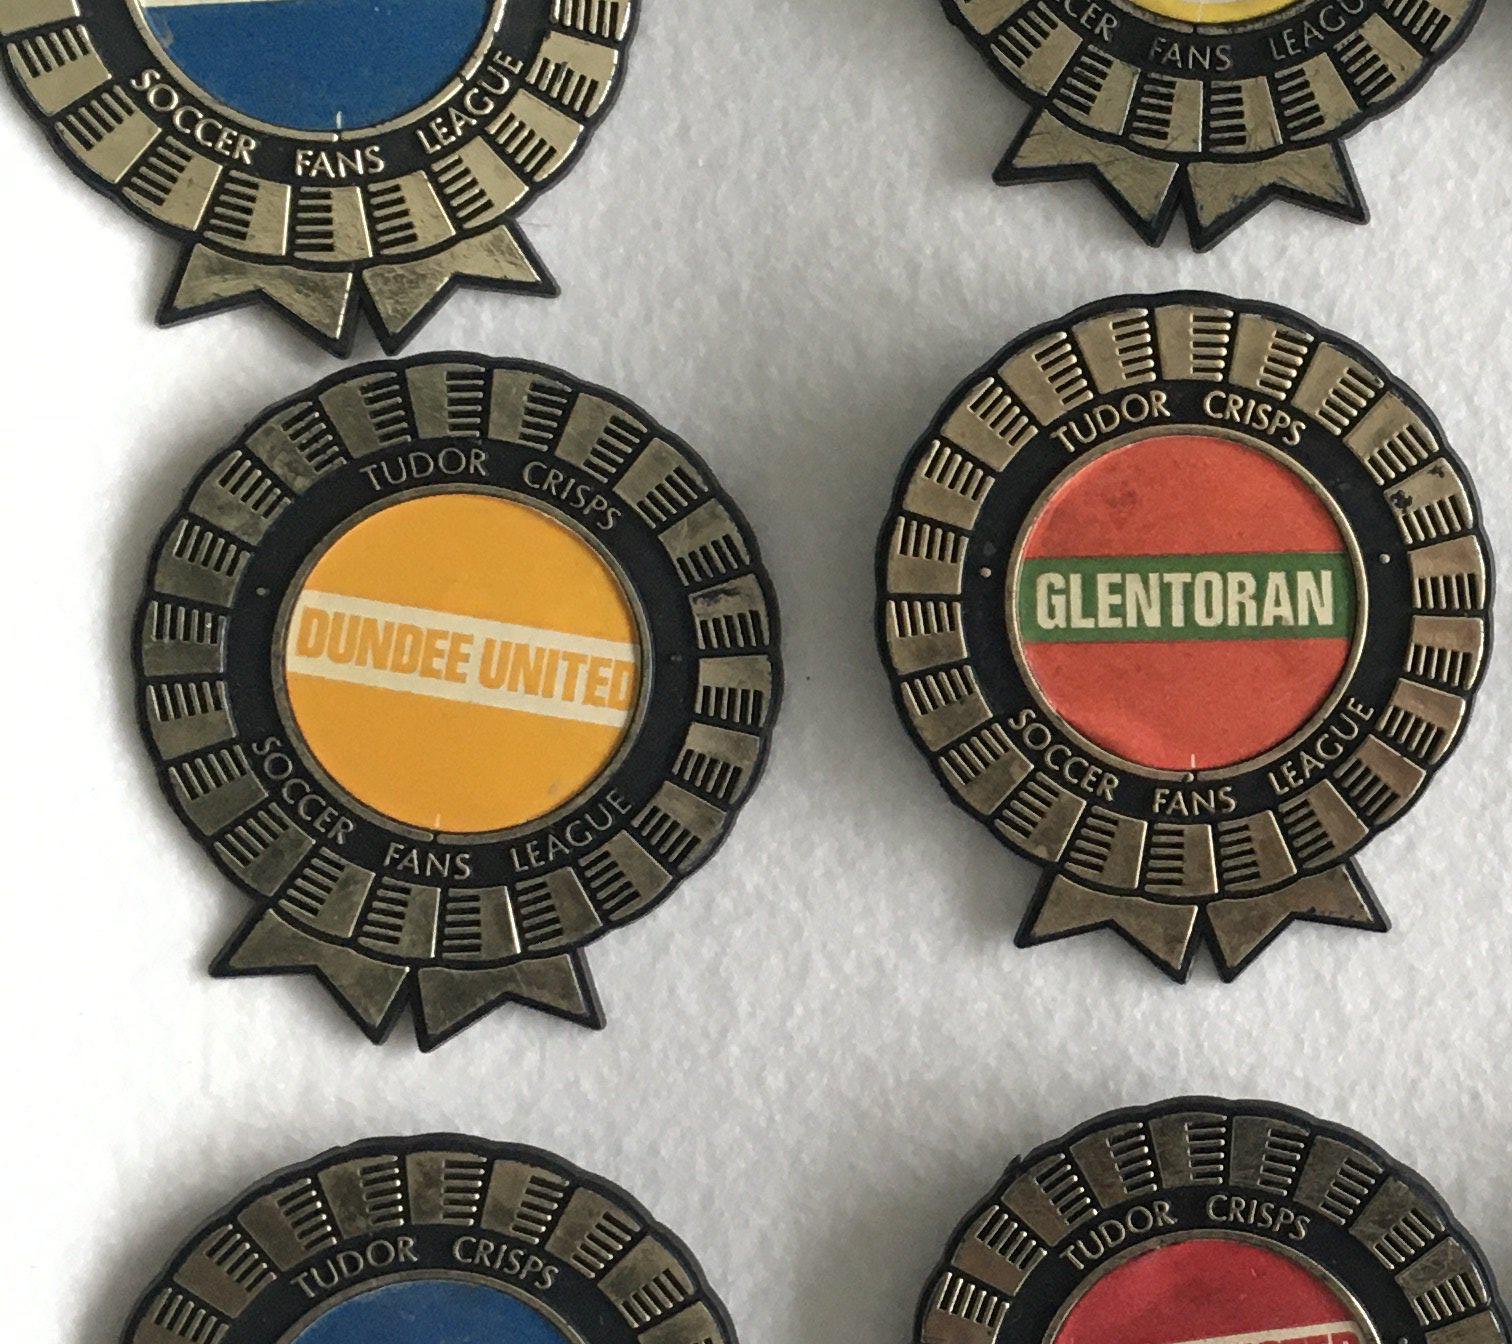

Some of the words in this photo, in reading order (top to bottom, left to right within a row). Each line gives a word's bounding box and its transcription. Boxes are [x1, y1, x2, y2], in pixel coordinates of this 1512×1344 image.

[1149, 37, 1234, 72] FANS
[132, 69, 259, 164] SOCCER
[294, 146, 385, 178] FANS
[416, 50, 525, 155] LEAGUE
[1050, 390, 1171, 453] TUDOR
[1203, 390, 1306, 446] CRISPS
[359, 447, 487, 491] TUDOR
[522, 461, 622, 531] CRISPS
[1035, 570, 1334, 629] GLENTORAN
[298, 607, 473, 684] DUNDEE
[478, 638, 636, 712] UNITED
[1007, 708, 1119, 802] SOCCER
[1152, 786, 1238, 817] FANS
[1267, 697, 1376, 796] LEAGUE
[251, 736, 356, 845] SOCCER
[383, 843, 472, 880] FANS
[510, 790, 633, 872] LEAGUE
[291, 1236, 418, 1300] TUDOR
[452, 1236, 560, 1290] CRISPS
[1060, 1200, 1178, 1271] TUDOR
[1206, 1195, 1311, 1241] CRISPS
